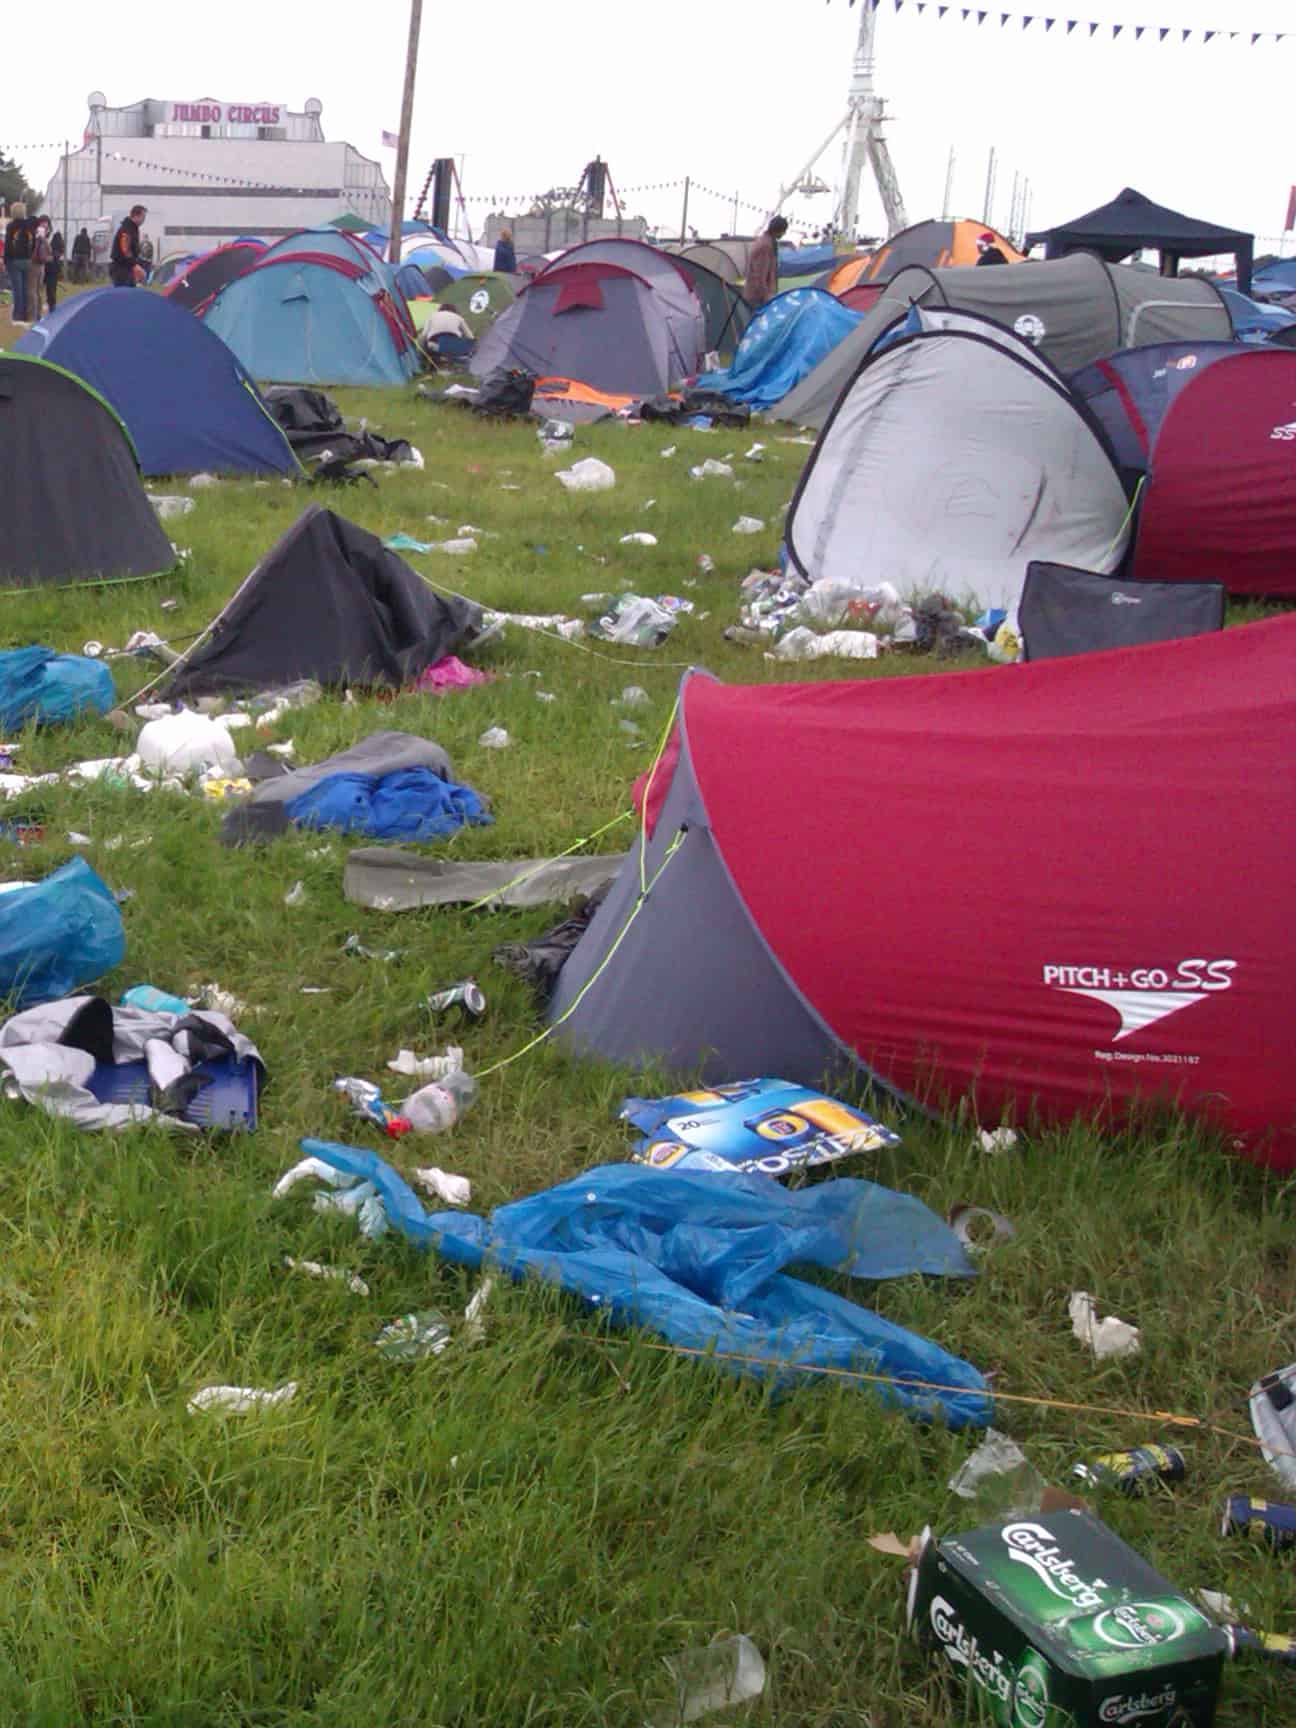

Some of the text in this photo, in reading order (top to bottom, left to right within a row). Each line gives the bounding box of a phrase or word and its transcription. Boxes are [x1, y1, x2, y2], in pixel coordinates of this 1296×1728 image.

[173, 103, 280, 123] JUMBO CIRCUS
[1171, 959, 1237, 990] SS
[677, 1120, 700, 1130] 20
[1002, 1522, 1103, 1608] Carlsberg
[930, 1595, 1010, 1700] Carlsberg
[1097, 1691, 1176, 1724] Carlsberg
